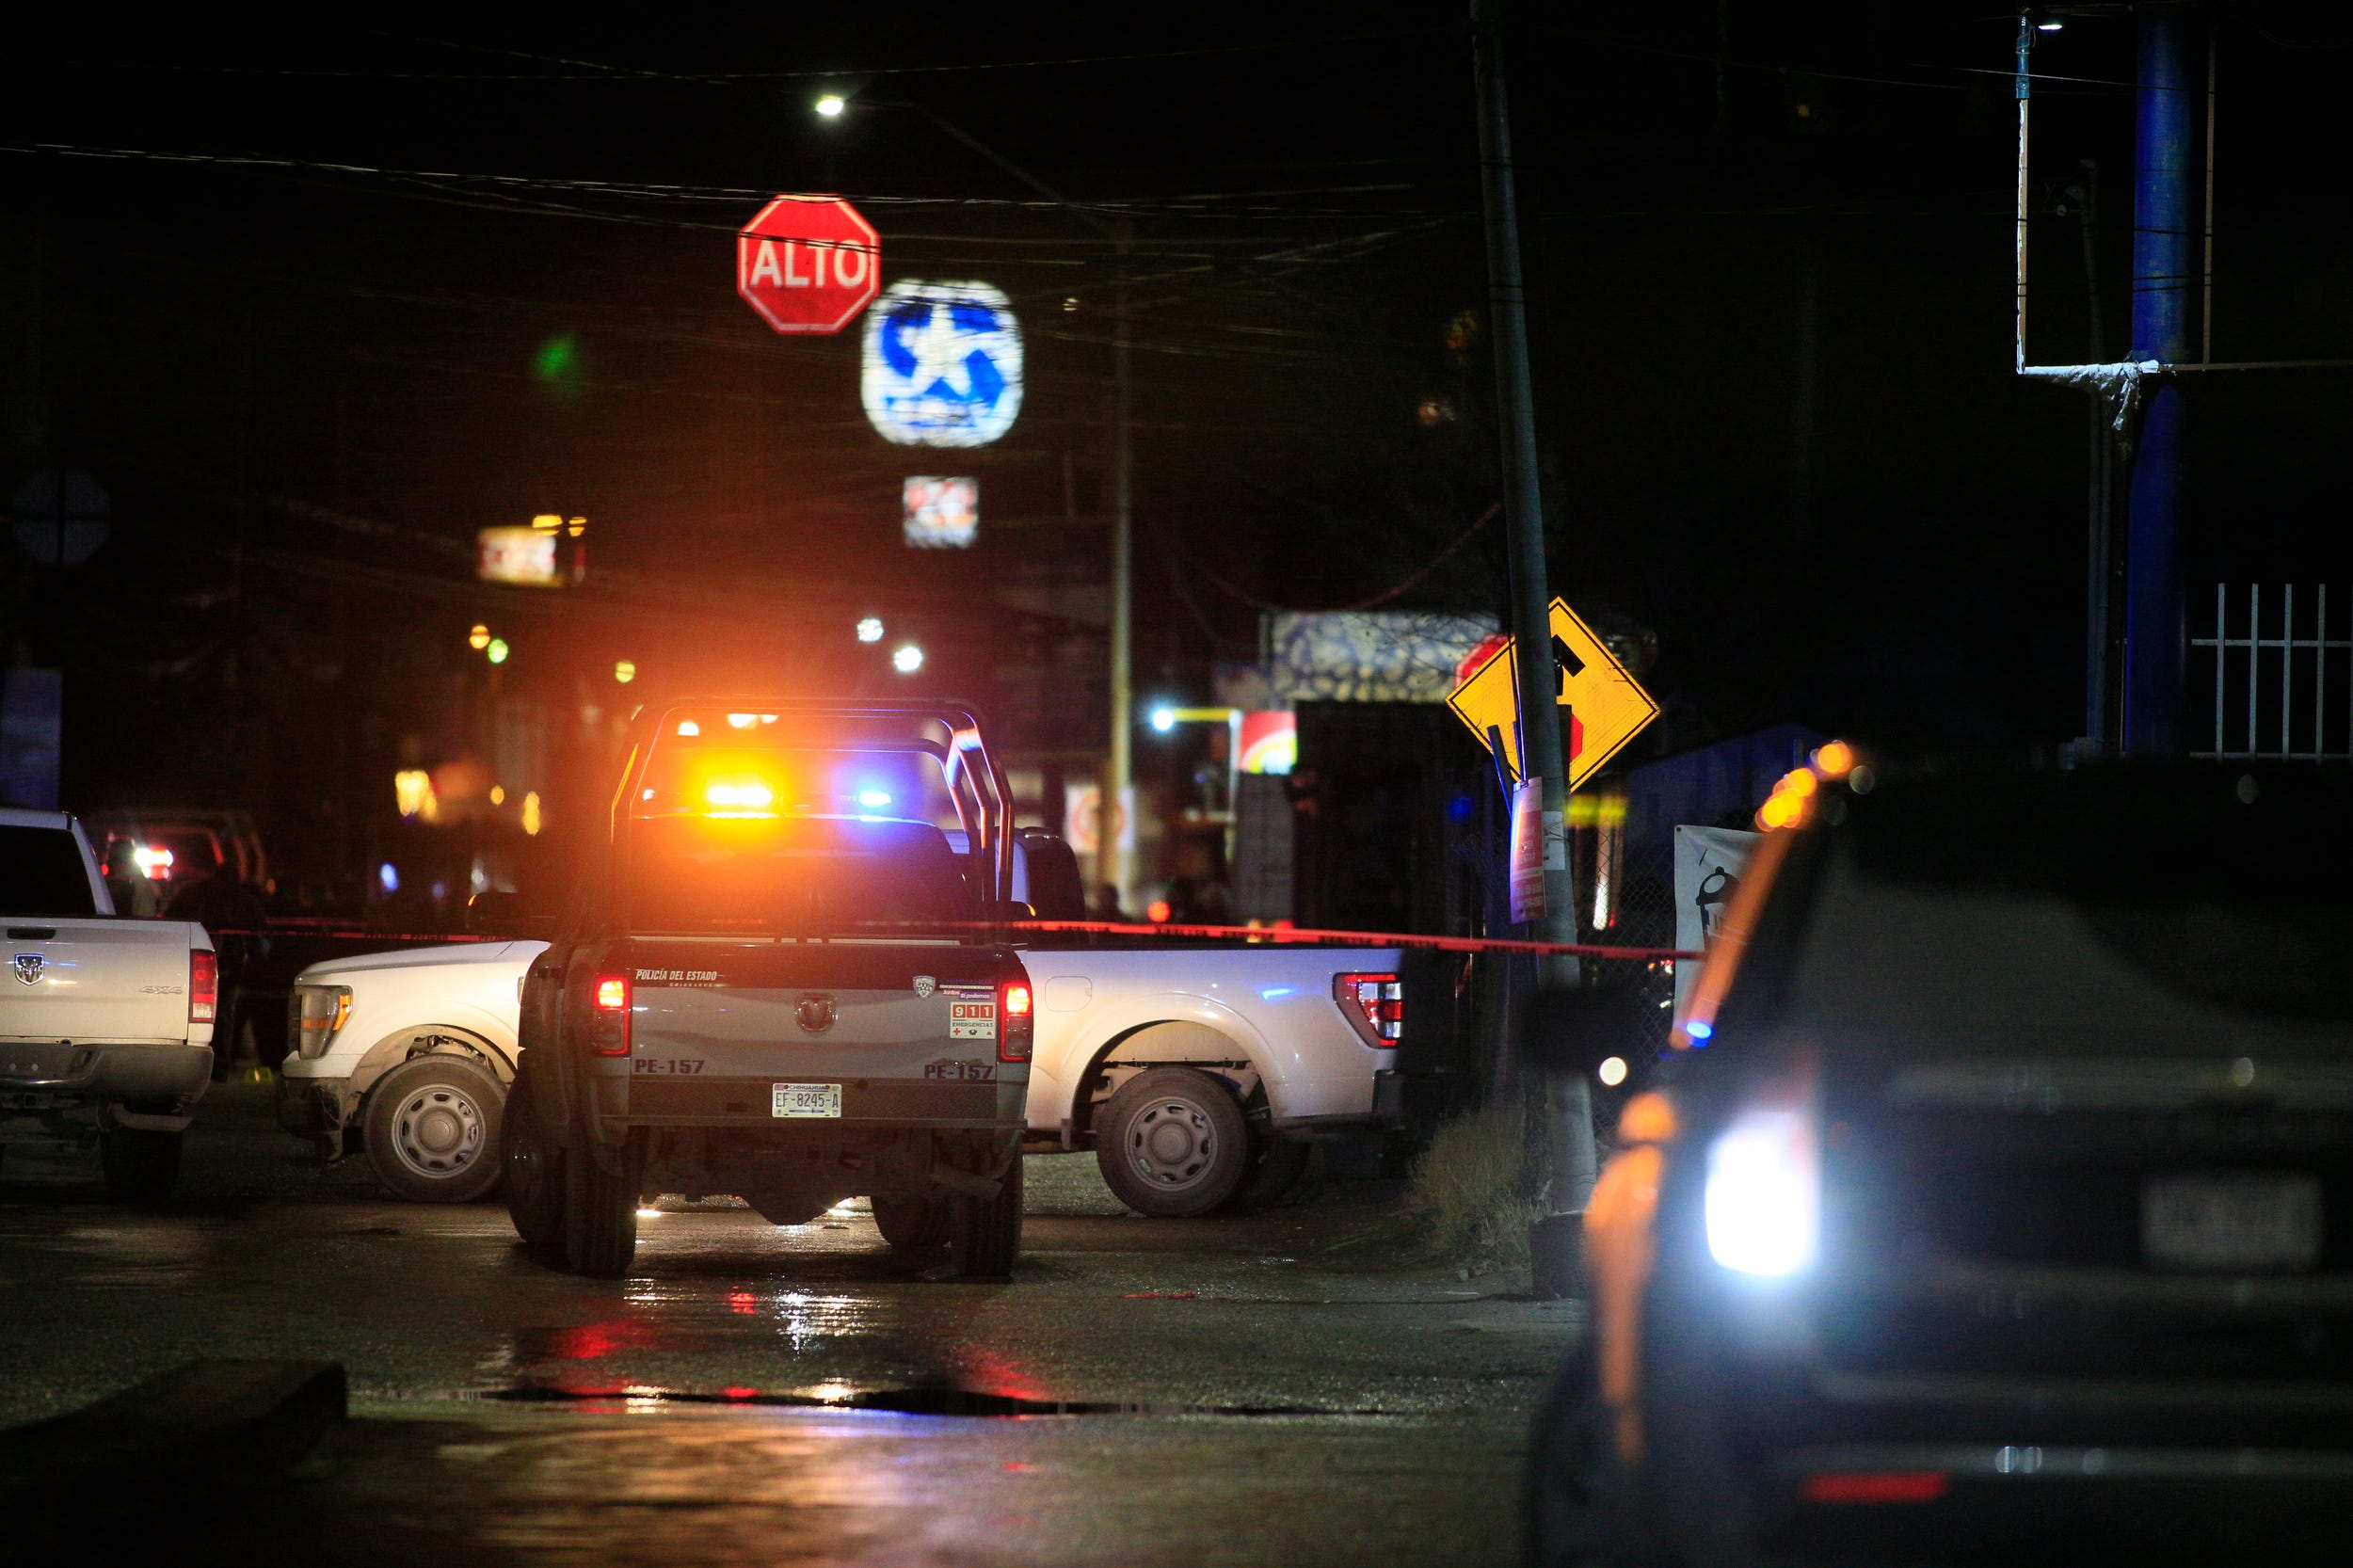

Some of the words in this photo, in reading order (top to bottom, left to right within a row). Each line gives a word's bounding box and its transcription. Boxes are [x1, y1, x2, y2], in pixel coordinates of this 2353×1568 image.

[750, 239, 868, 288] ALTO
[635, 968, 667, 980] POLICÍA
[669, 971, 685, 981] DEL
[686, 971, 717, 981] ESTADO
[634, 1059, 705, 1074] PE-157
[924, 1064, 994, 1080] PE-157
[776, 1093, 839, 1108] EF-8245-A
